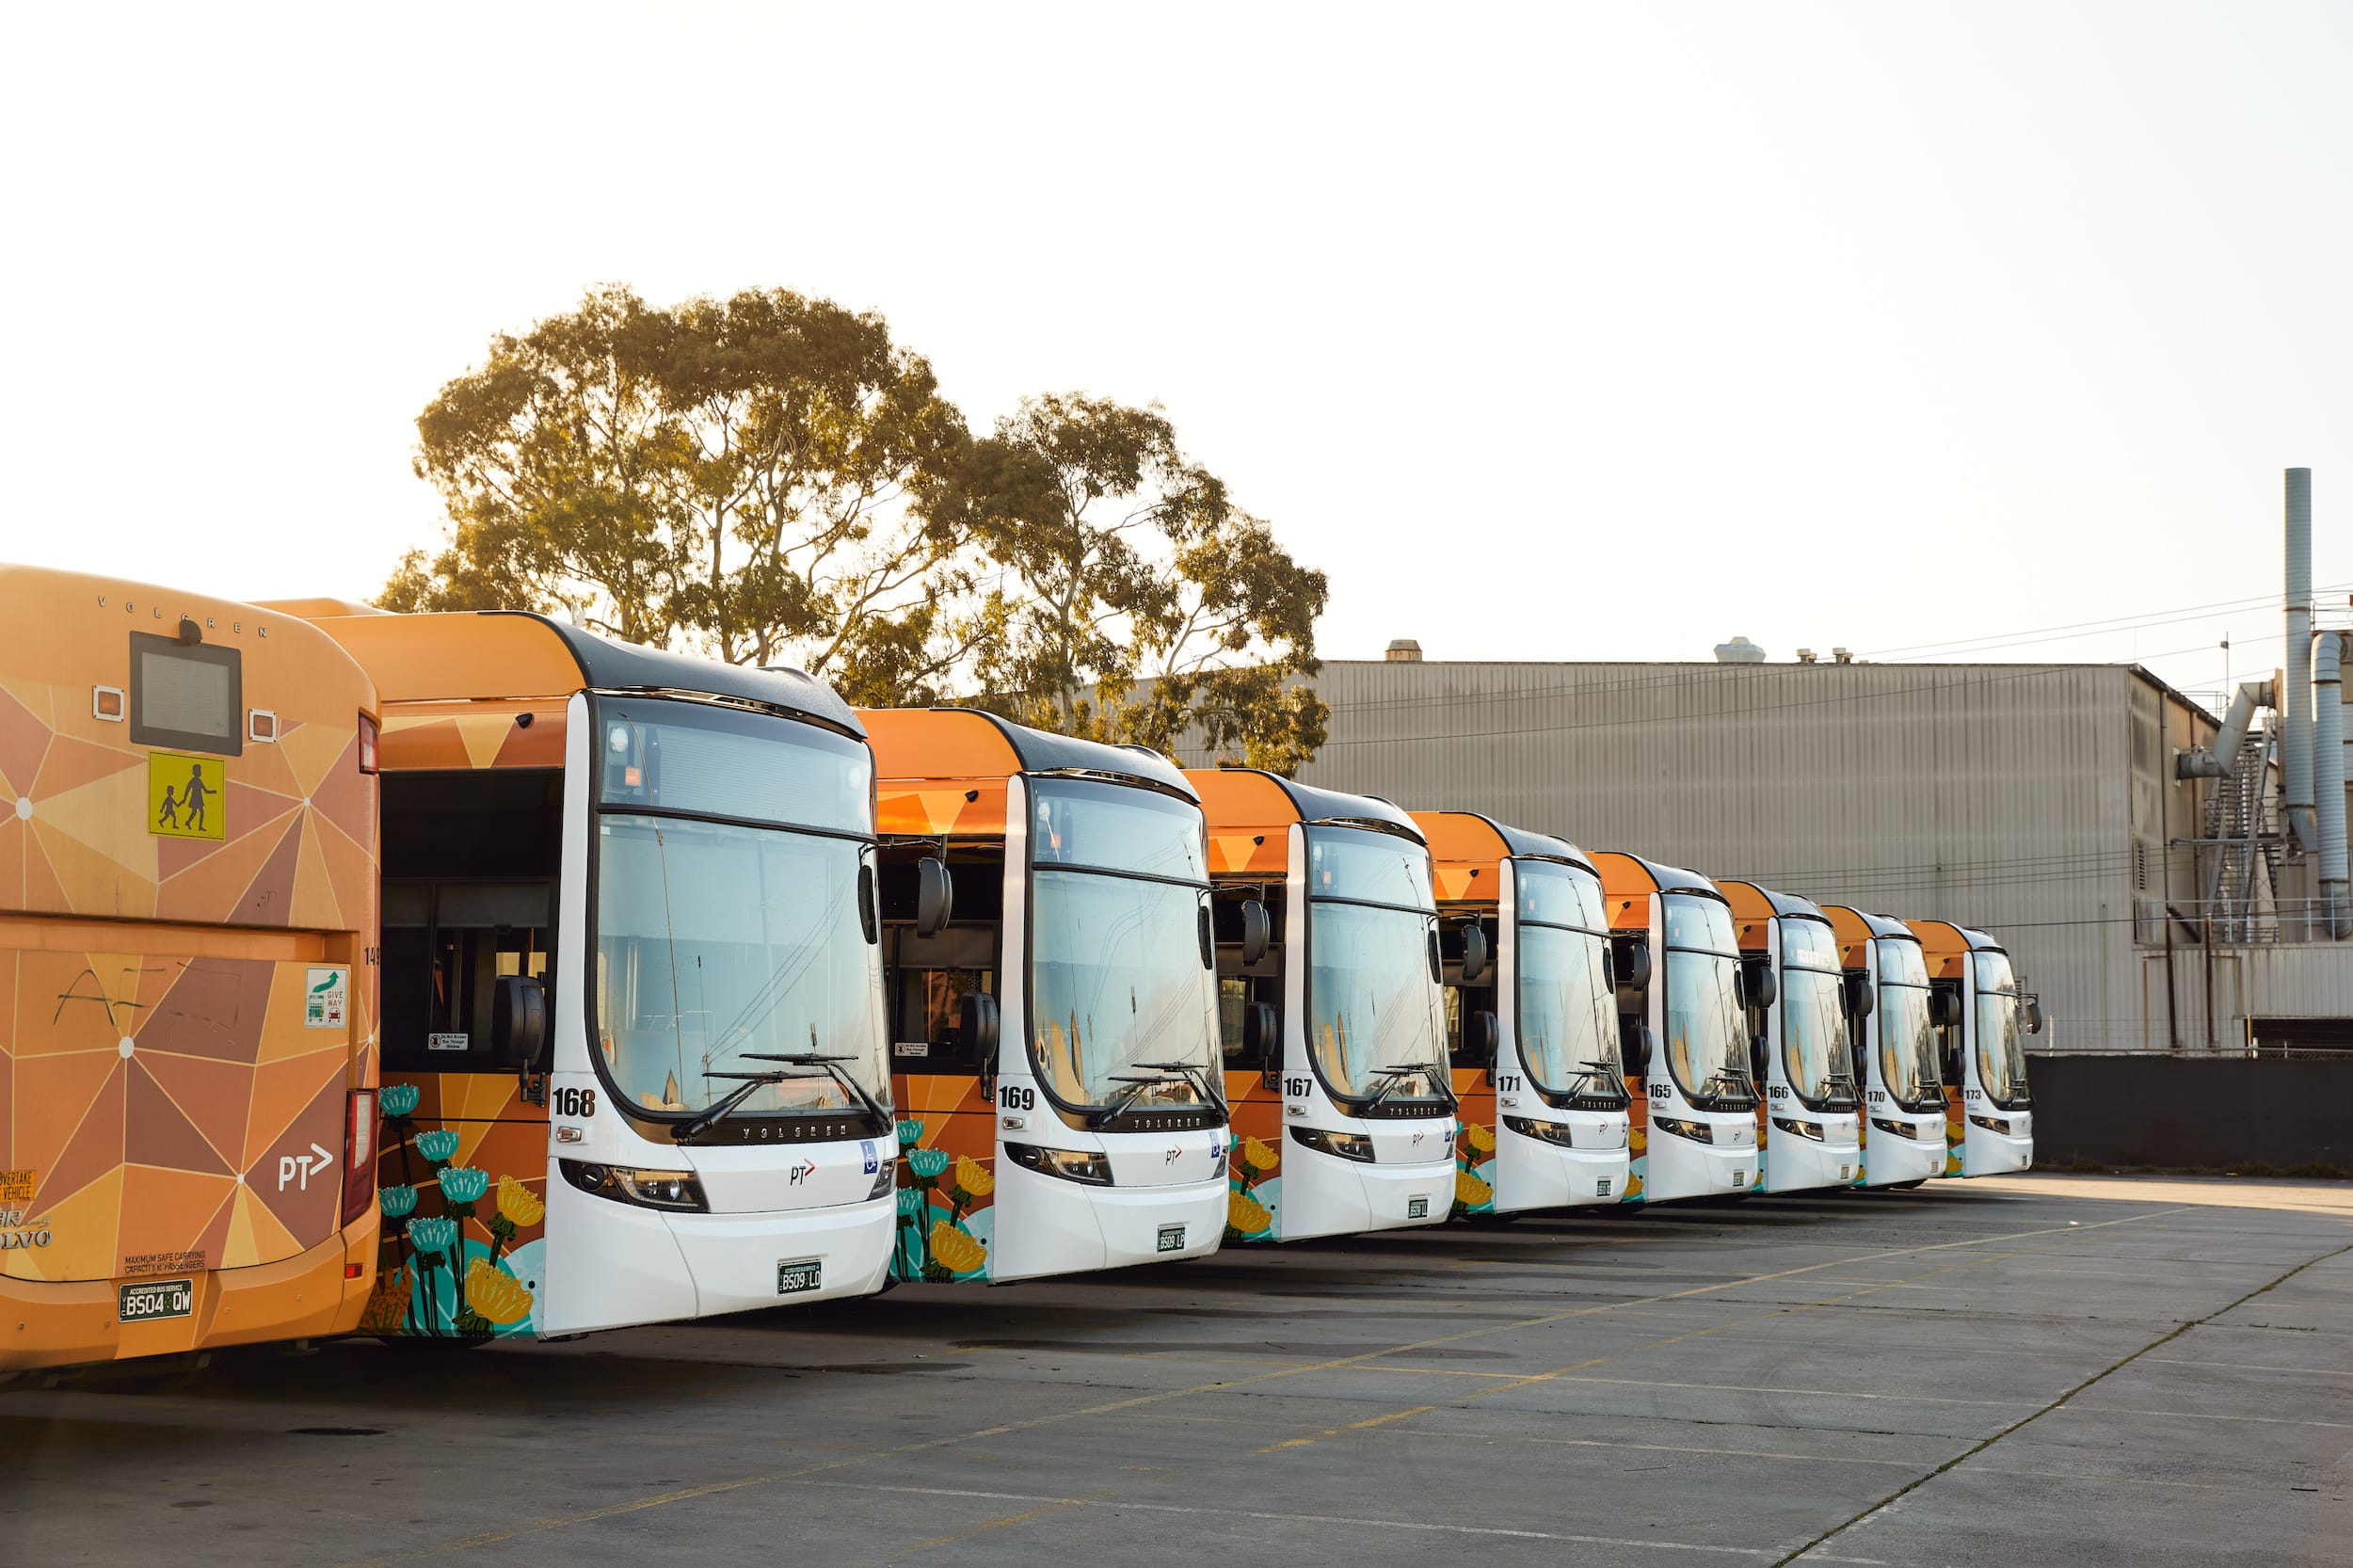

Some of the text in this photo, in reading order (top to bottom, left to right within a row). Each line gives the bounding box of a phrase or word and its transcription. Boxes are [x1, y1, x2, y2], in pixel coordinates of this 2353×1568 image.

[1284, 1078, 1313, 1097] 167
[1498, 1076, 1521, 1092] 171
[1648, 1083, 1672, 1098] 165
[998, 1085, 1035, 1111] 169
[1768, 1086, 1789, 1099] 166
[1867, 1091, 1885, 1102] 170
[1965, 1089, 1981, 1100] 173
[552, 1087, 596, 1118] 168
[4, 1186, 31, 1200] VEHICLE
[0, 1230, 53, 1250] LVO
[125, 1250, 206, 1265] MAXIMUM SAFE CARRYING
[782, 1272, 806, 1290] BS09
[129, 1284, 184, 1296] ACCREDITED BUS SERVICE
[126, 1293, 164, 1316] BS04
